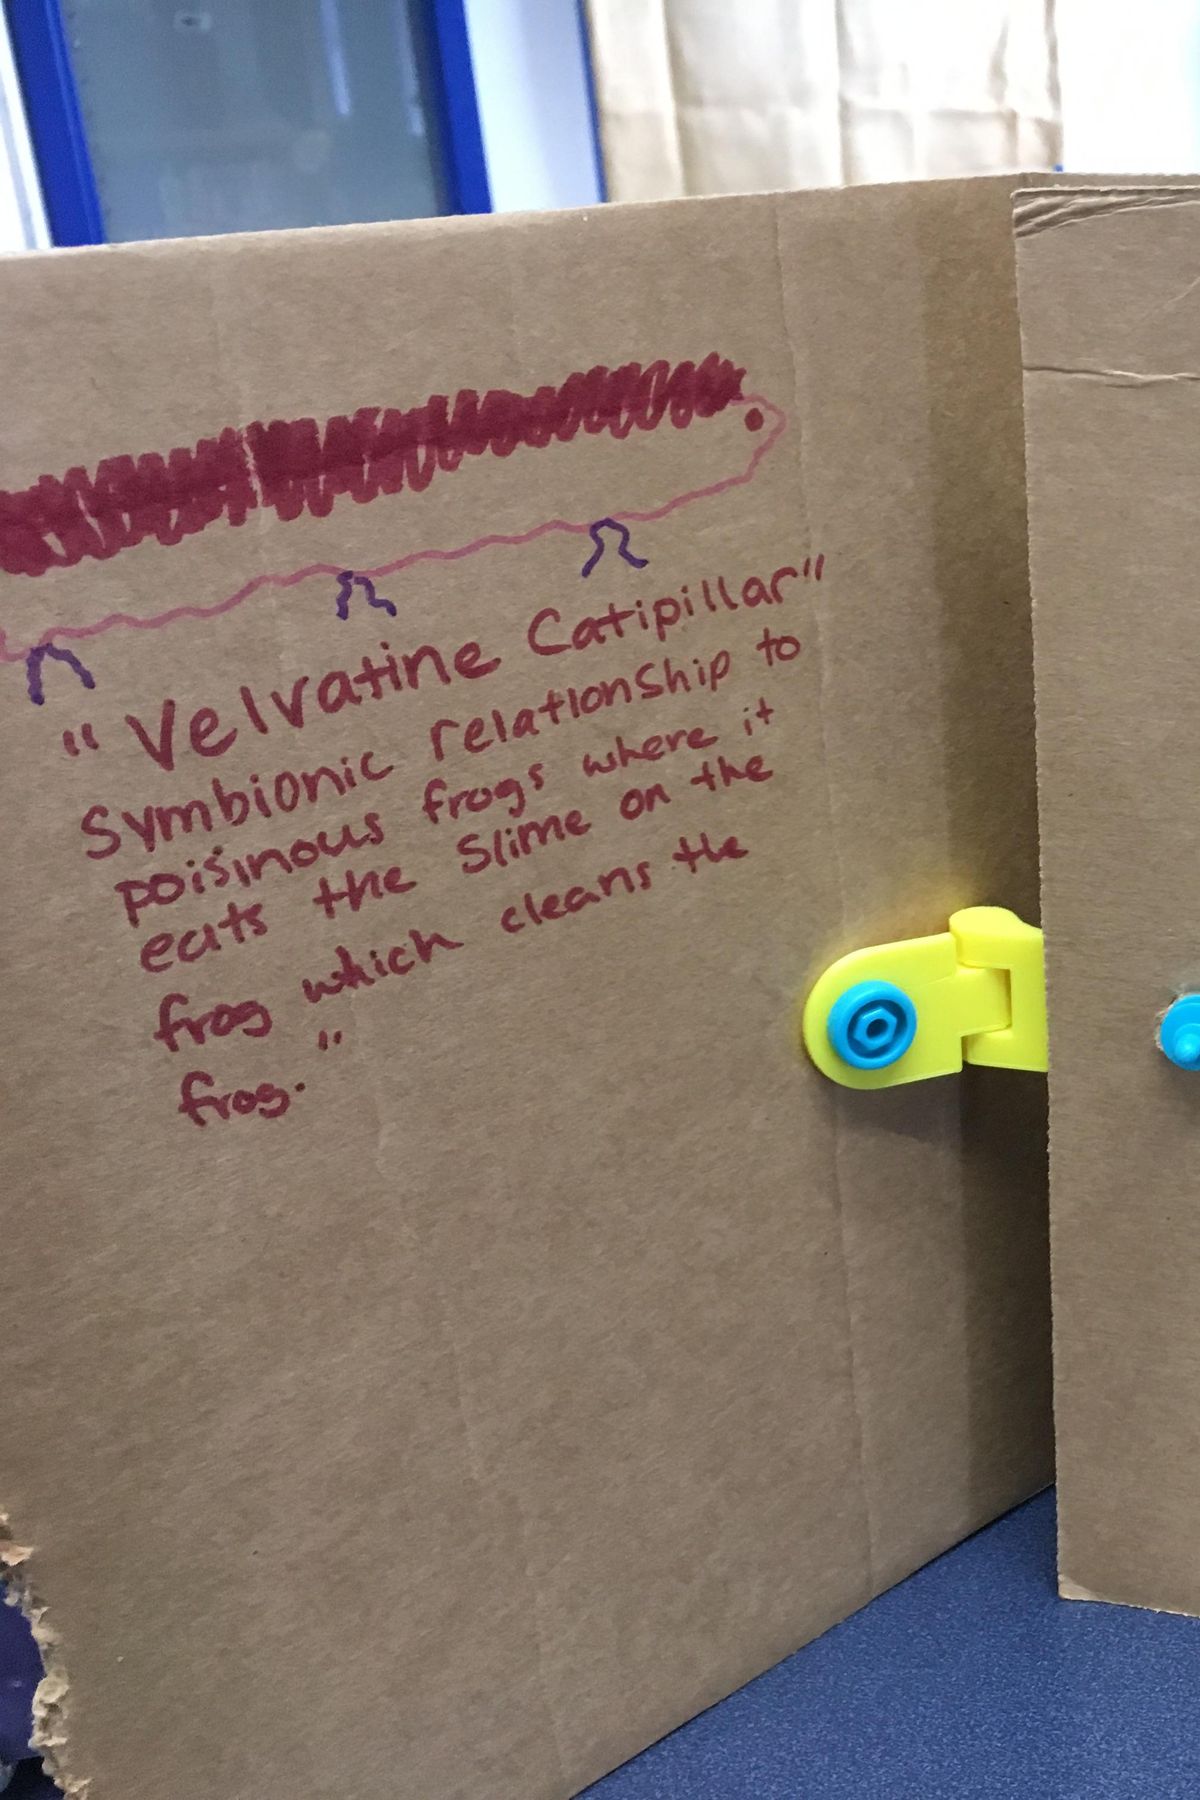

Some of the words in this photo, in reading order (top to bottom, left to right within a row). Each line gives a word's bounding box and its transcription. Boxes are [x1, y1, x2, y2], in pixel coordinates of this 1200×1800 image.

[756, 627, 802, 666] to
[115, 812, 385, 928] poisinous
[421, 763, 545, 824] frogs
[582, 727, 719, 777] where
[743, 697, 775, 736] it
[140, 901, 268, 973] eats
[312, 866, 418, 919] the
[619, 782, 672, 821] on
[690, 754, 775, 791] the
[153, 993, 273, 1052] frog
[301, 929, 465, 1003] which
[500, 858, 653, 935] cleans
[671, 831, 751, 870] the
